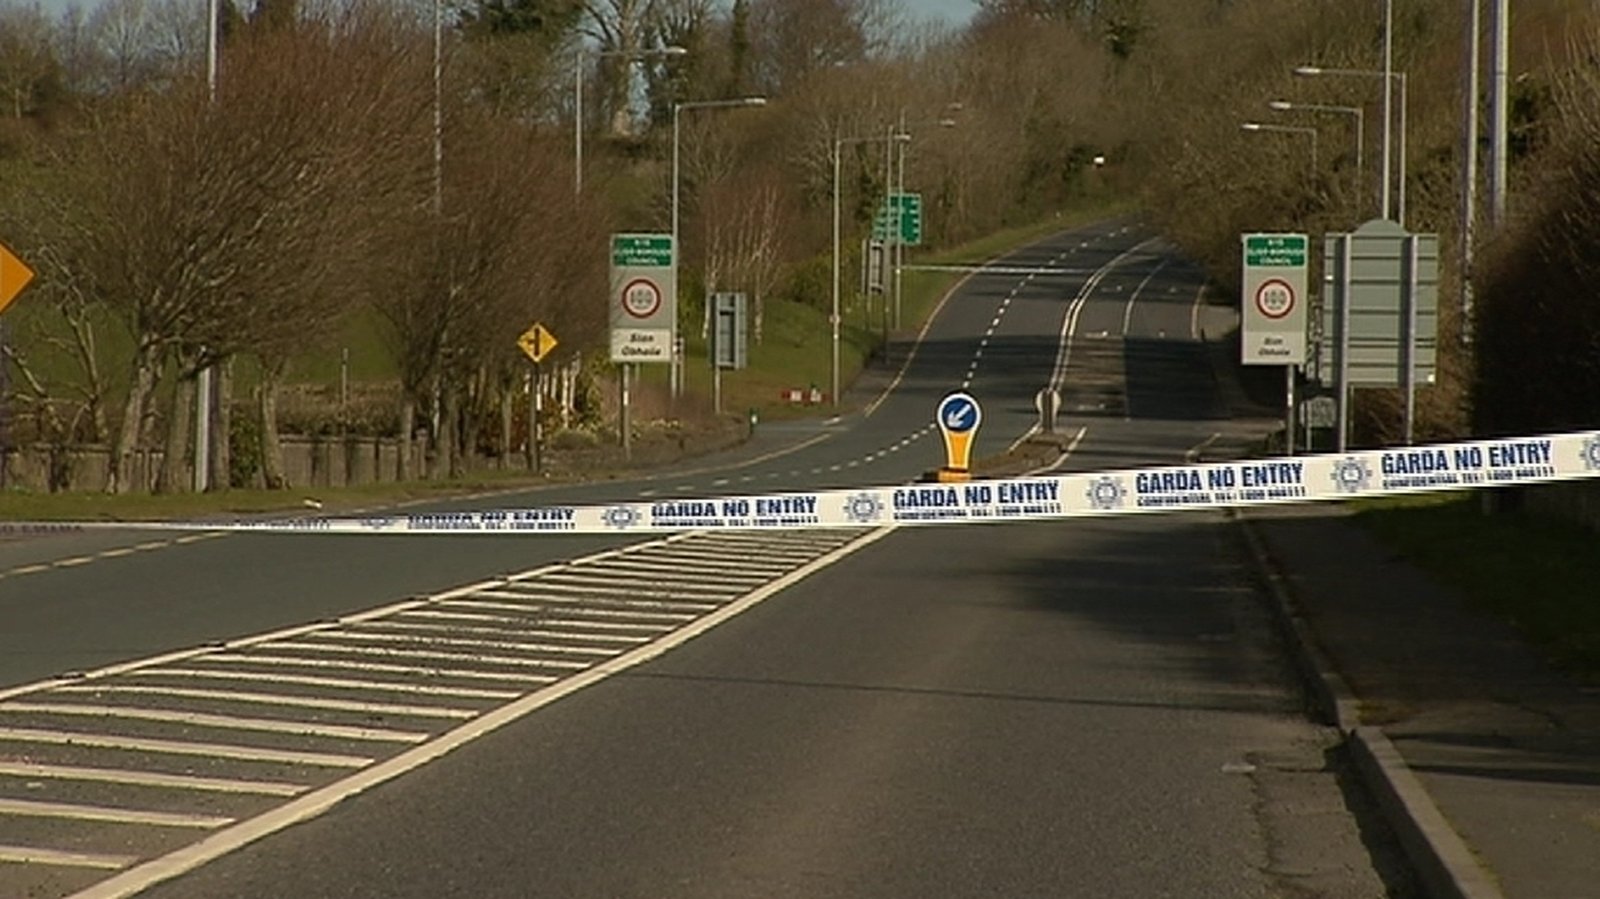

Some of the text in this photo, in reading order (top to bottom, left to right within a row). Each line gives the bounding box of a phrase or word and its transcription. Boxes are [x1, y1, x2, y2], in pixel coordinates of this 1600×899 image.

[1381, 440, 1551, 474] GARDA NO ENTRY
[1136, 461, 1303, 493] GARDA NO ENTRY
[651, 496, 816, 517] GARDA NO ENTRY
[894, 480, 1059, 509] GARDA NO ENTRY
